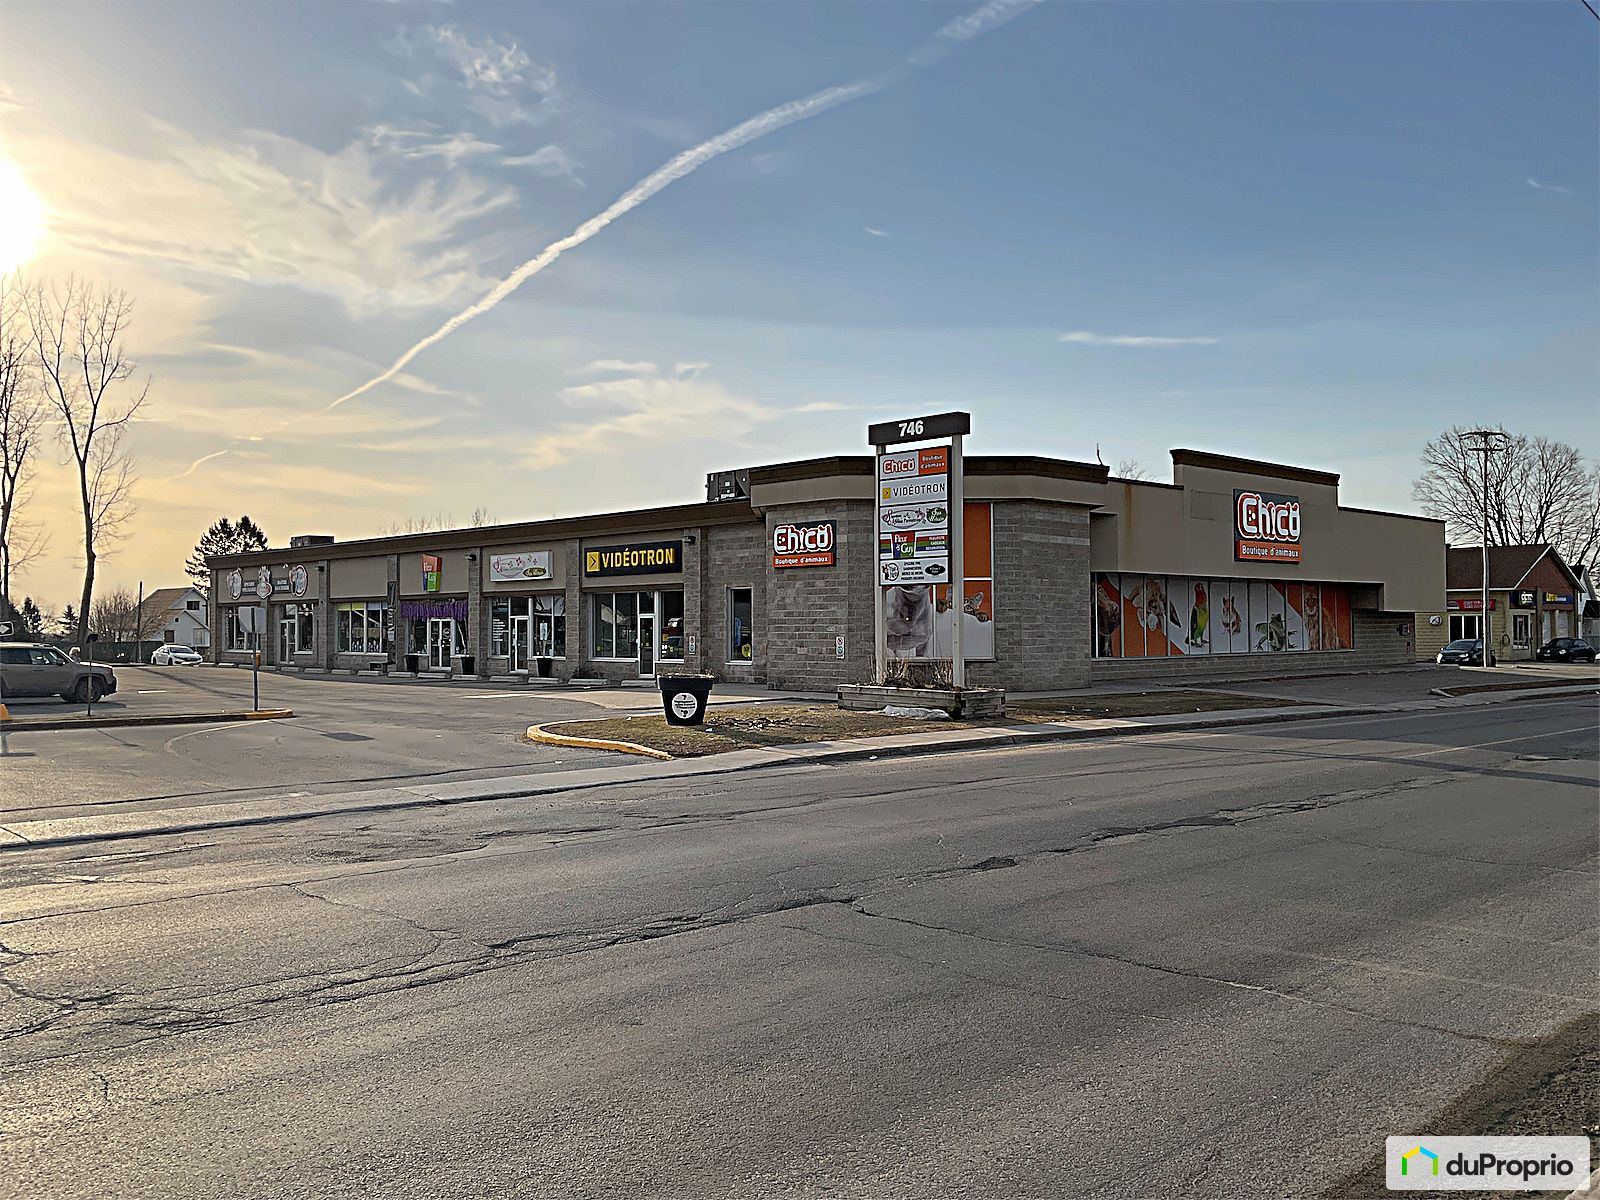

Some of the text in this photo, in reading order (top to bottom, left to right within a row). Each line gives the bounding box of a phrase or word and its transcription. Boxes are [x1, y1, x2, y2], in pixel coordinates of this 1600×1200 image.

[899, 420, 924, 437] 746
[893, 483, 945, 497] VIDÉOTRON
[602, 548, 675, 568] VIDÉOTRON
[1242, 545, 1298, 557] Boutique d'animaux
[800, 556, 828, 564] d'animaux
